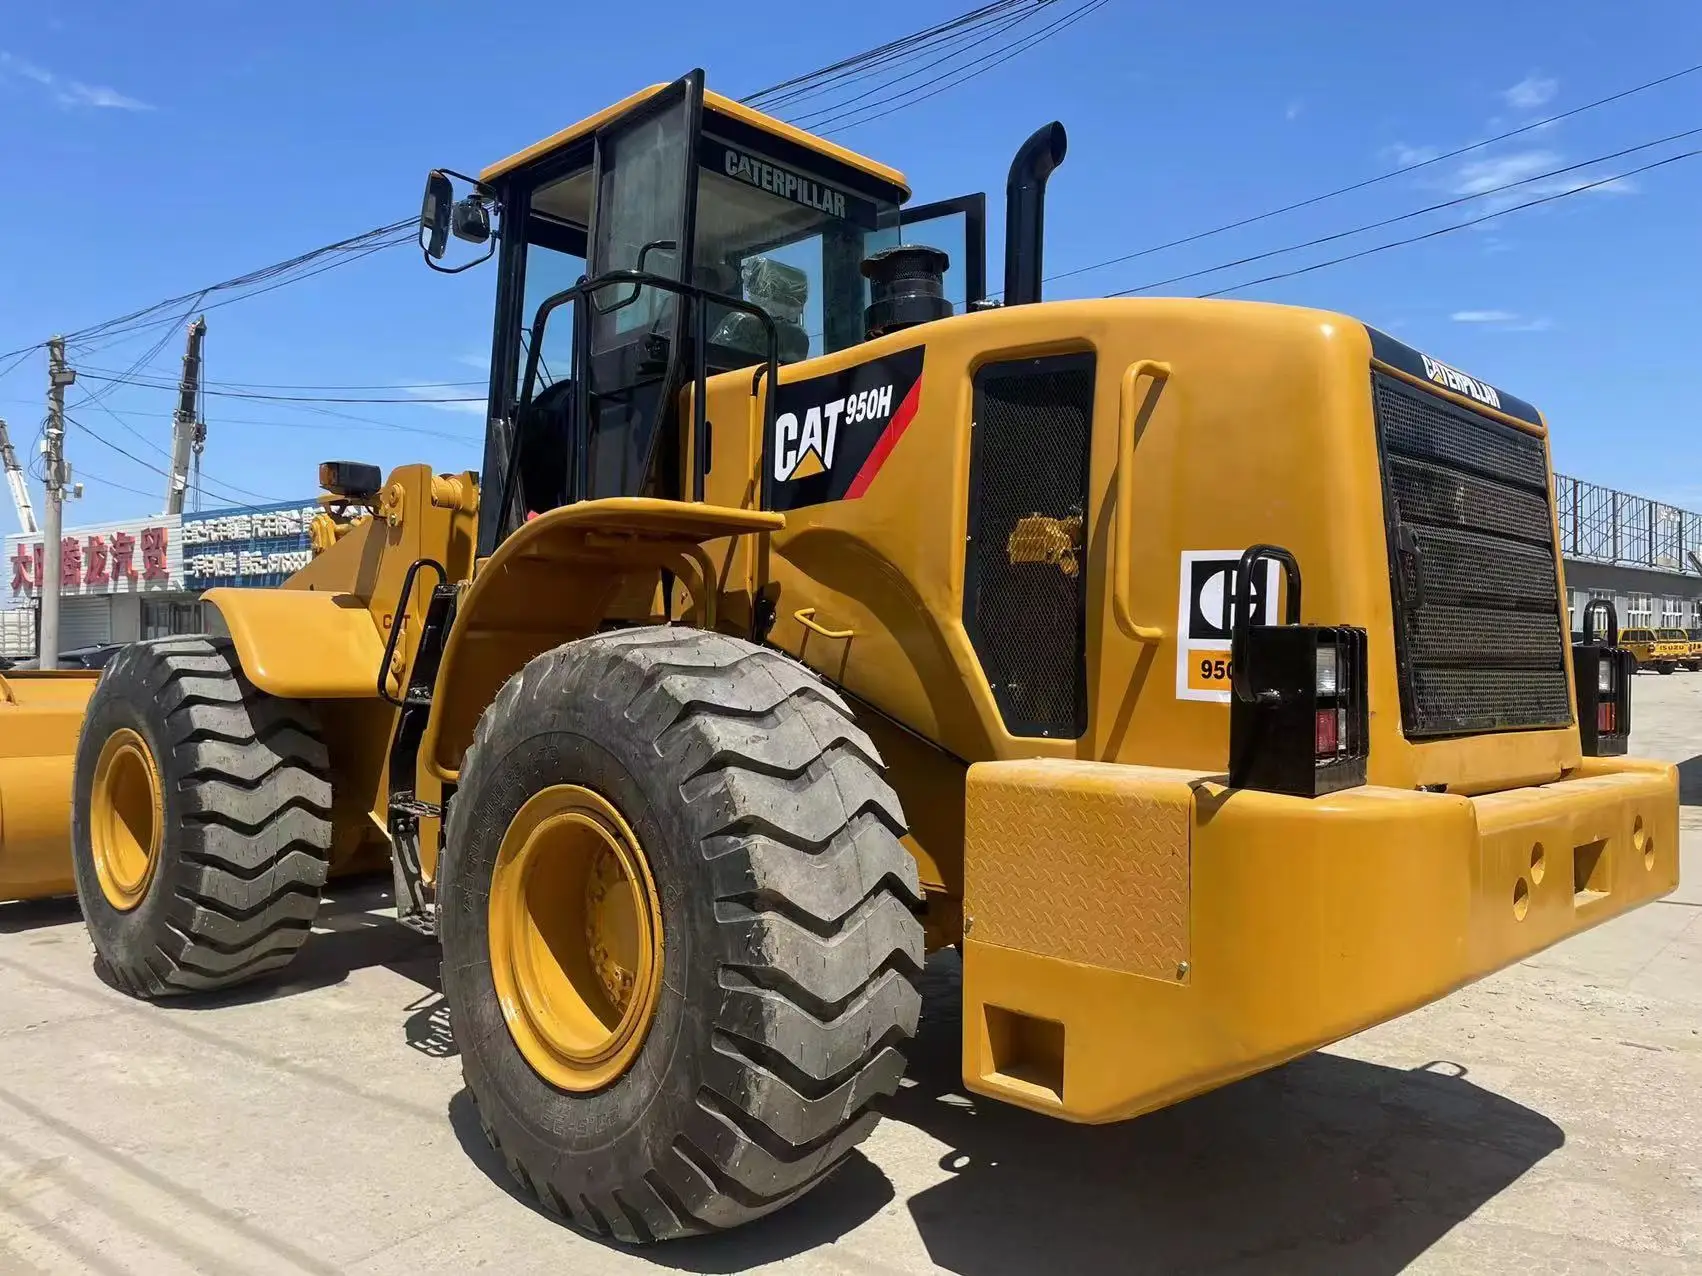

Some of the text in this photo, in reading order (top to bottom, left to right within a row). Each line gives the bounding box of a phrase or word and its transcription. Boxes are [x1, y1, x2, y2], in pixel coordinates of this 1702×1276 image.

[725, 150, 846, 219] CATERPILLAR
[1420, 354, 1501, 410] CATERPILLAR
[774, 384, 893, 482] CAT 950H
[383, 613, 411, 630] CT
